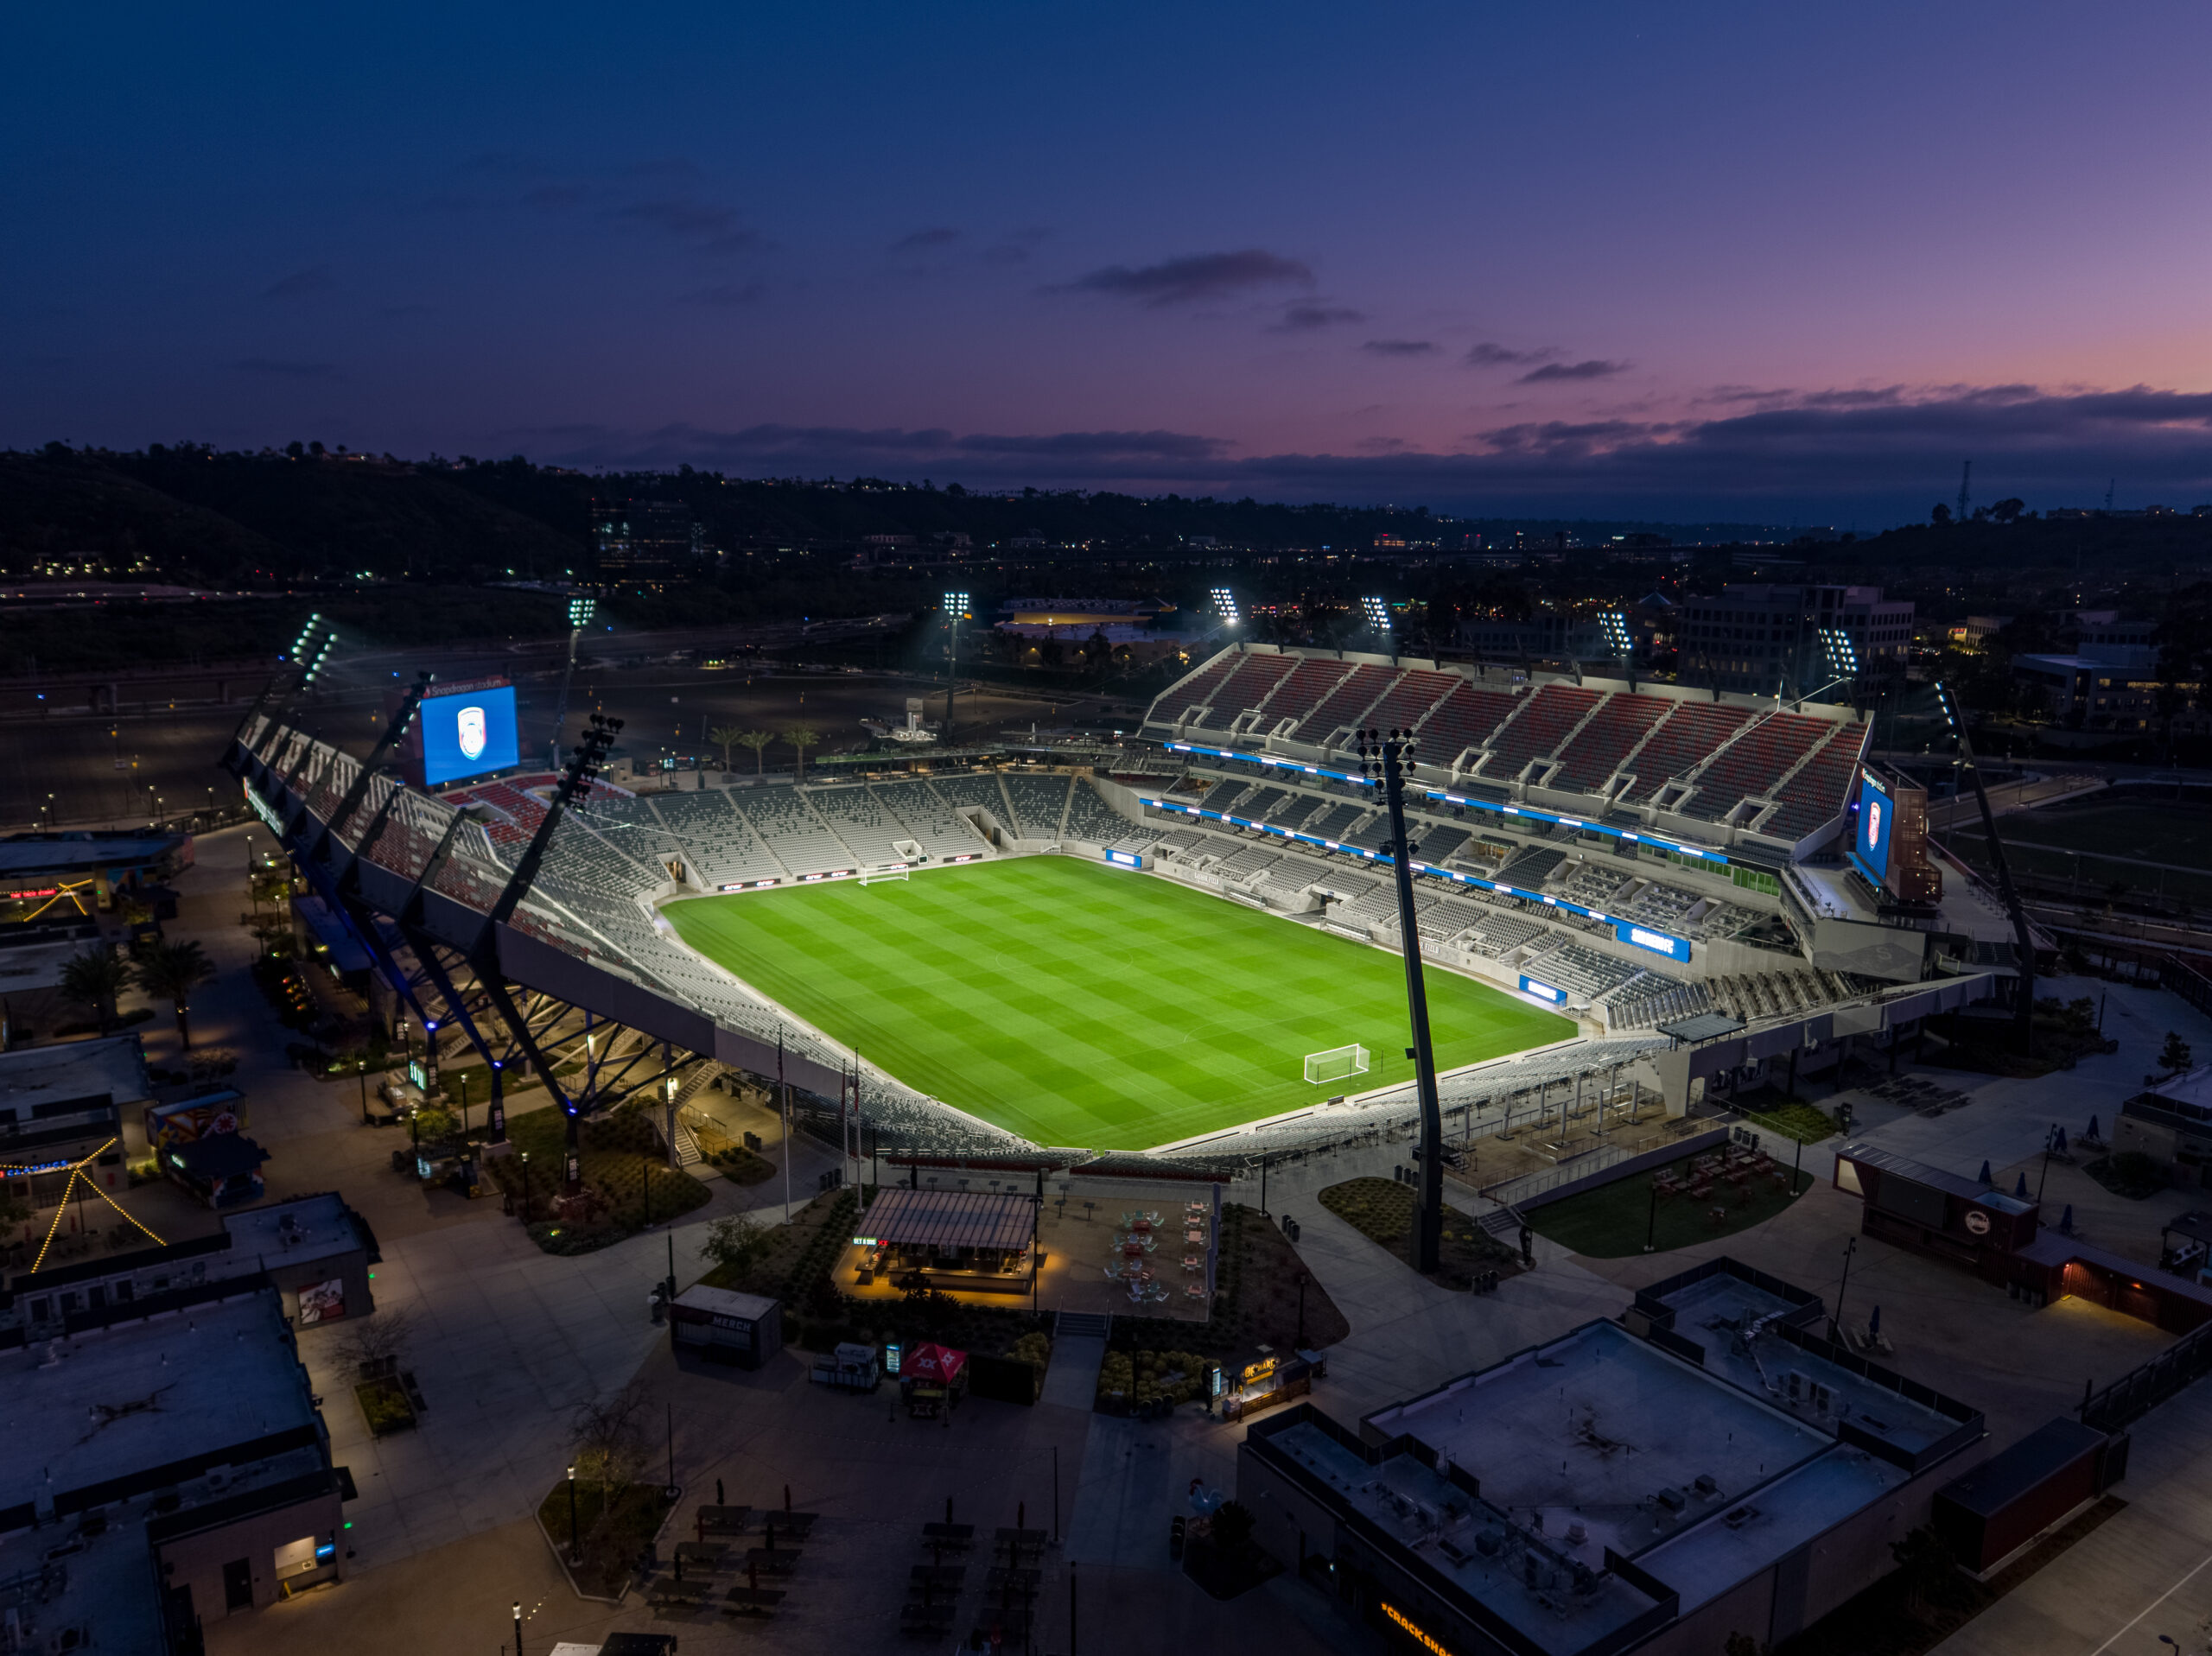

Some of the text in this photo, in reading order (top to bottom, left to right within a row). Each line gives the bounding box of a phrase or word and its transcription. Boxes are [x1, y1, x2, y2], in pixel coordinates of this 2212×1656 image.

[713, 1316, 752, 1331] MERCH
[1387, 1605, 1452, 1656] CRACK SHA
